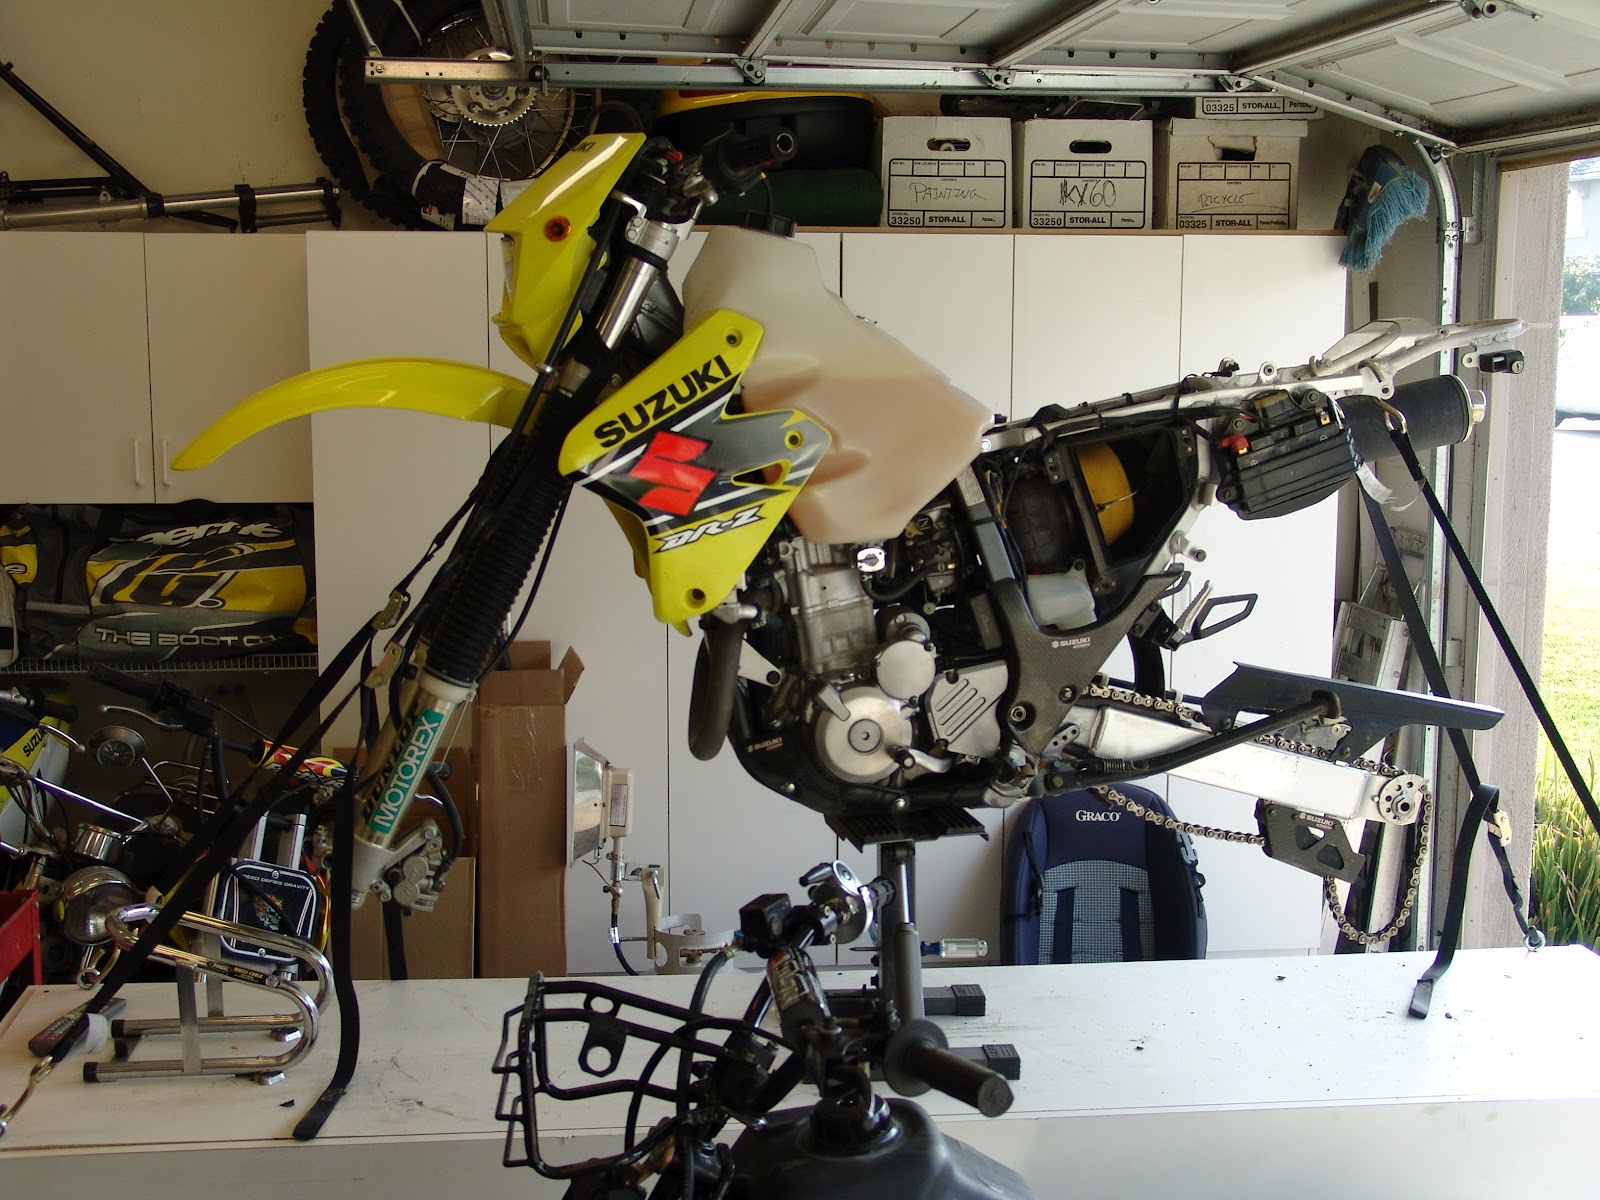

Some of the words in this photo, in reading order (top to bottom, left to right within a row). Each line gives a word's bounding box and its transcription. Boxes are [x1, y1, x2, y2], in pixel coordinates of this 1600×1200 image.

[1205, 103, 1235, 112] 03325
[909, 182, 986, 203] PAINTING
[891, 216, 921, 225] 33250
[928, 215, 966, 223] STOR-ALL
[1033, 217, 1062, 226] 33250
[1069, 216, 1106, 224] STOR-ALL
[1179, 220, 1207, 229] 03325
[1215, 219, 1252, 227] STOR-ALL
[593, 354, 732, 448] SUZUKI
[653, 503, 766, 553] DR-Z
[95, 627, 151, 646] THE
[158, 632, 239, 647] BOOT
[1060, 636, 1091, 647] SUZUKI
[23, 728, 47, 758] SUZU
[373, 716, 439, 828] MOTOREX
[1075, 809, 1120, 822] GRACO
[1306, 814, 1335, 827] SUZUKI
[283, 882, 311, 891] GRAVITY
